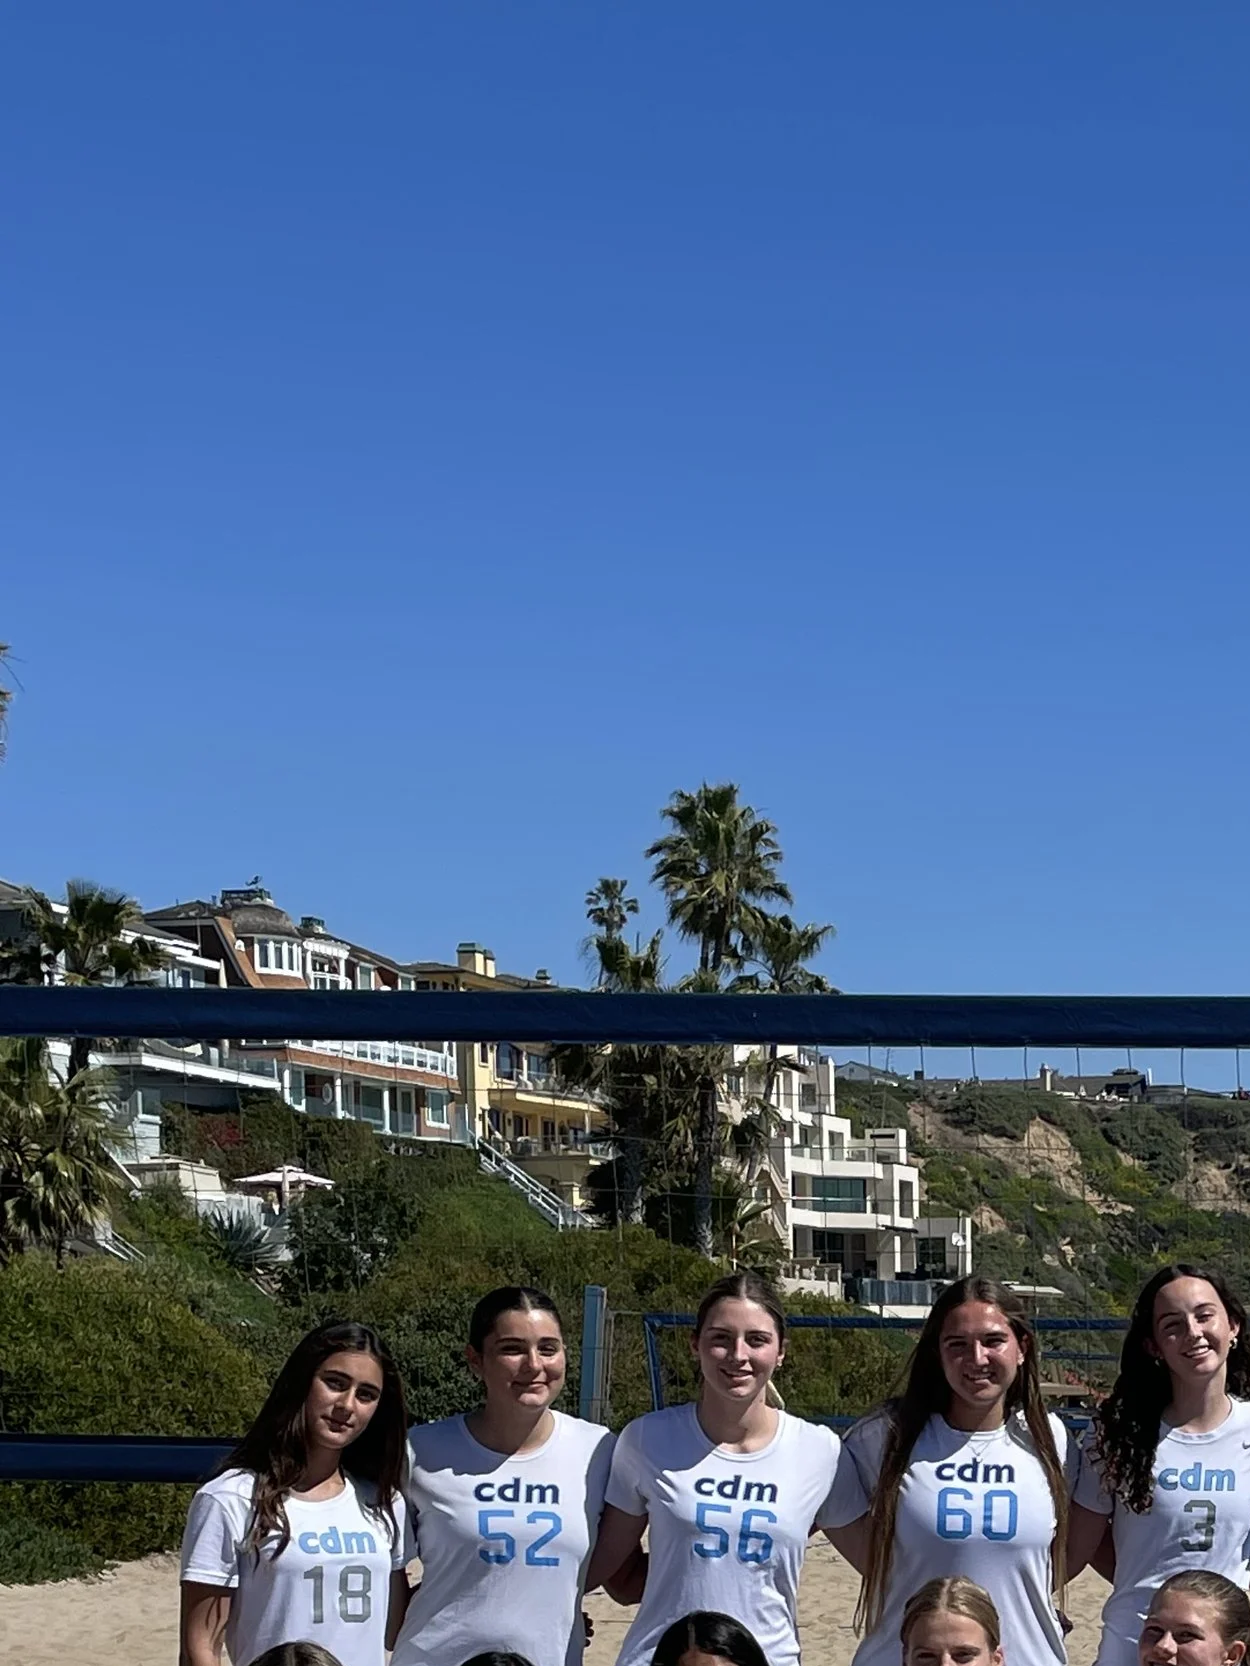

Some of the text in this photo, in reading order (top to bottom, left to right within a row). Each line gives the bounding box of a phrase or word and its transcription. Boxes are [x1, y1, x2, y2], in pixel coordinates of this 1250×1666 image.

[474, 1475, 559, 1504] cdm
[694, 1474, 777, 1503] cdm
[935, 1457, 1015, 1483] cdm
[1159, 1463, 1235, 1492] cdm
[694, 1503, 777, 1563] 56
[936, 1487, 1018, 1542] 60
[1182, 1499, 1217, 1552] 3
[299, 1526, 376, 1555] cdm
[478, 1509, 562, 1567] 52
[303, 1565, 371, 1624] 18
